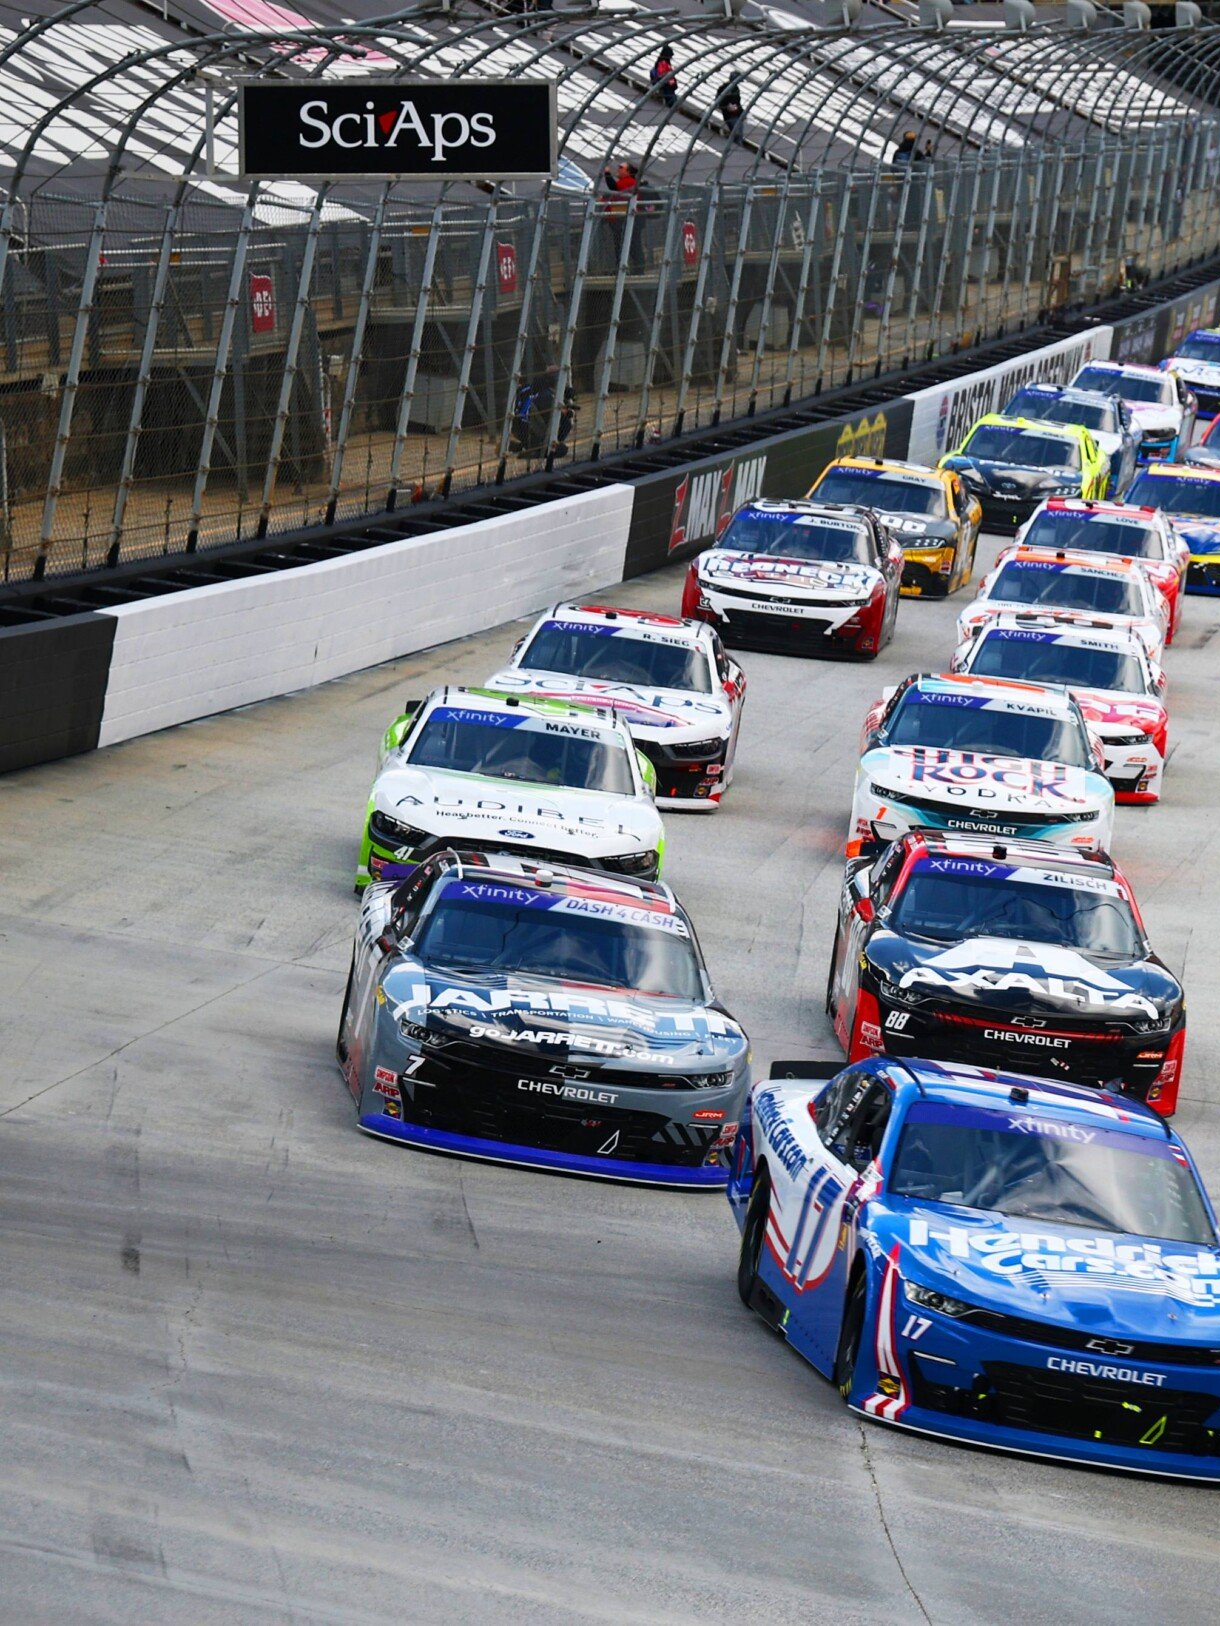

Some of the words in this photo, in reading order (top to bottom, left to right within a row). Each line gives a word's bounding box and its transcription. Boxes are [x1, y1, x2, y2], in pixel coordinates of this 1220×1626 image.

[299, 100, 497, 161] SciAps
[836, 467, 873, 476] xfinity
[902, 475, 926, 483] GRAY
[748, 511, 789, 522] xfinity
[1047, 510, 1085, 520] xfinity
[1115, 516, 1139, 525] LOVE
[820, 519, 862, 531] BURTON
[1013, 561, 1056, 572] xfinity
[1080, 566, 1126, 578] SANCHEZ
[751, 602, 805, 614] CHEVROLET
[552, 621, 605, 634] xfinity
[998, 630, 1047, 642] xfinity
[1080, 638, 1119, 650] SMITH
[920, 693, 974, 707] xfinity
[1006, 702, 1057, 716] KVAPIL
[446, 709, 507, 726] xfinity
[545, 722, 601, 740] MAYER
[911, 764, 1086, 804] ROCK
[396, 795, 642, 843] AUDIBEL
[876, 807, 888, 821] 1
[503, 830, 528, 839] Ford
[948, 820, 1018, 836] CHEVROLET
[394, 847, 414, 862] 41
[930, 858, 998, 877] xfinity
[1042, 872, 1108, 891] ZILISCH
[461, 883, 541, 906] xfinity
[565, 898, 614, 917] DASH
[615, 906, 626, 919] 4
[629, 911, 675, 930] CASH
[899, 966, 1160, 1021] AXALTA
[490, 1009, 595, 1021] TRANSPORTATION
[885, 1010, 911, 1030] 88
[469, 1024, 675, 1065] goJARRETT.com
[983, 1029, 1073, 1049] CHEVROLET
[404, 1055, 426, 1076] 7
[374, 1082, 400, 1098] ARP
[517, 1079, 619, 1105] CHEVROLET
[1008, 1116, 1097, 1145] xfinity
[901, 1315, 933, 1341] 17
[1047, 1356, 1168, 1388] CHEVROLET
